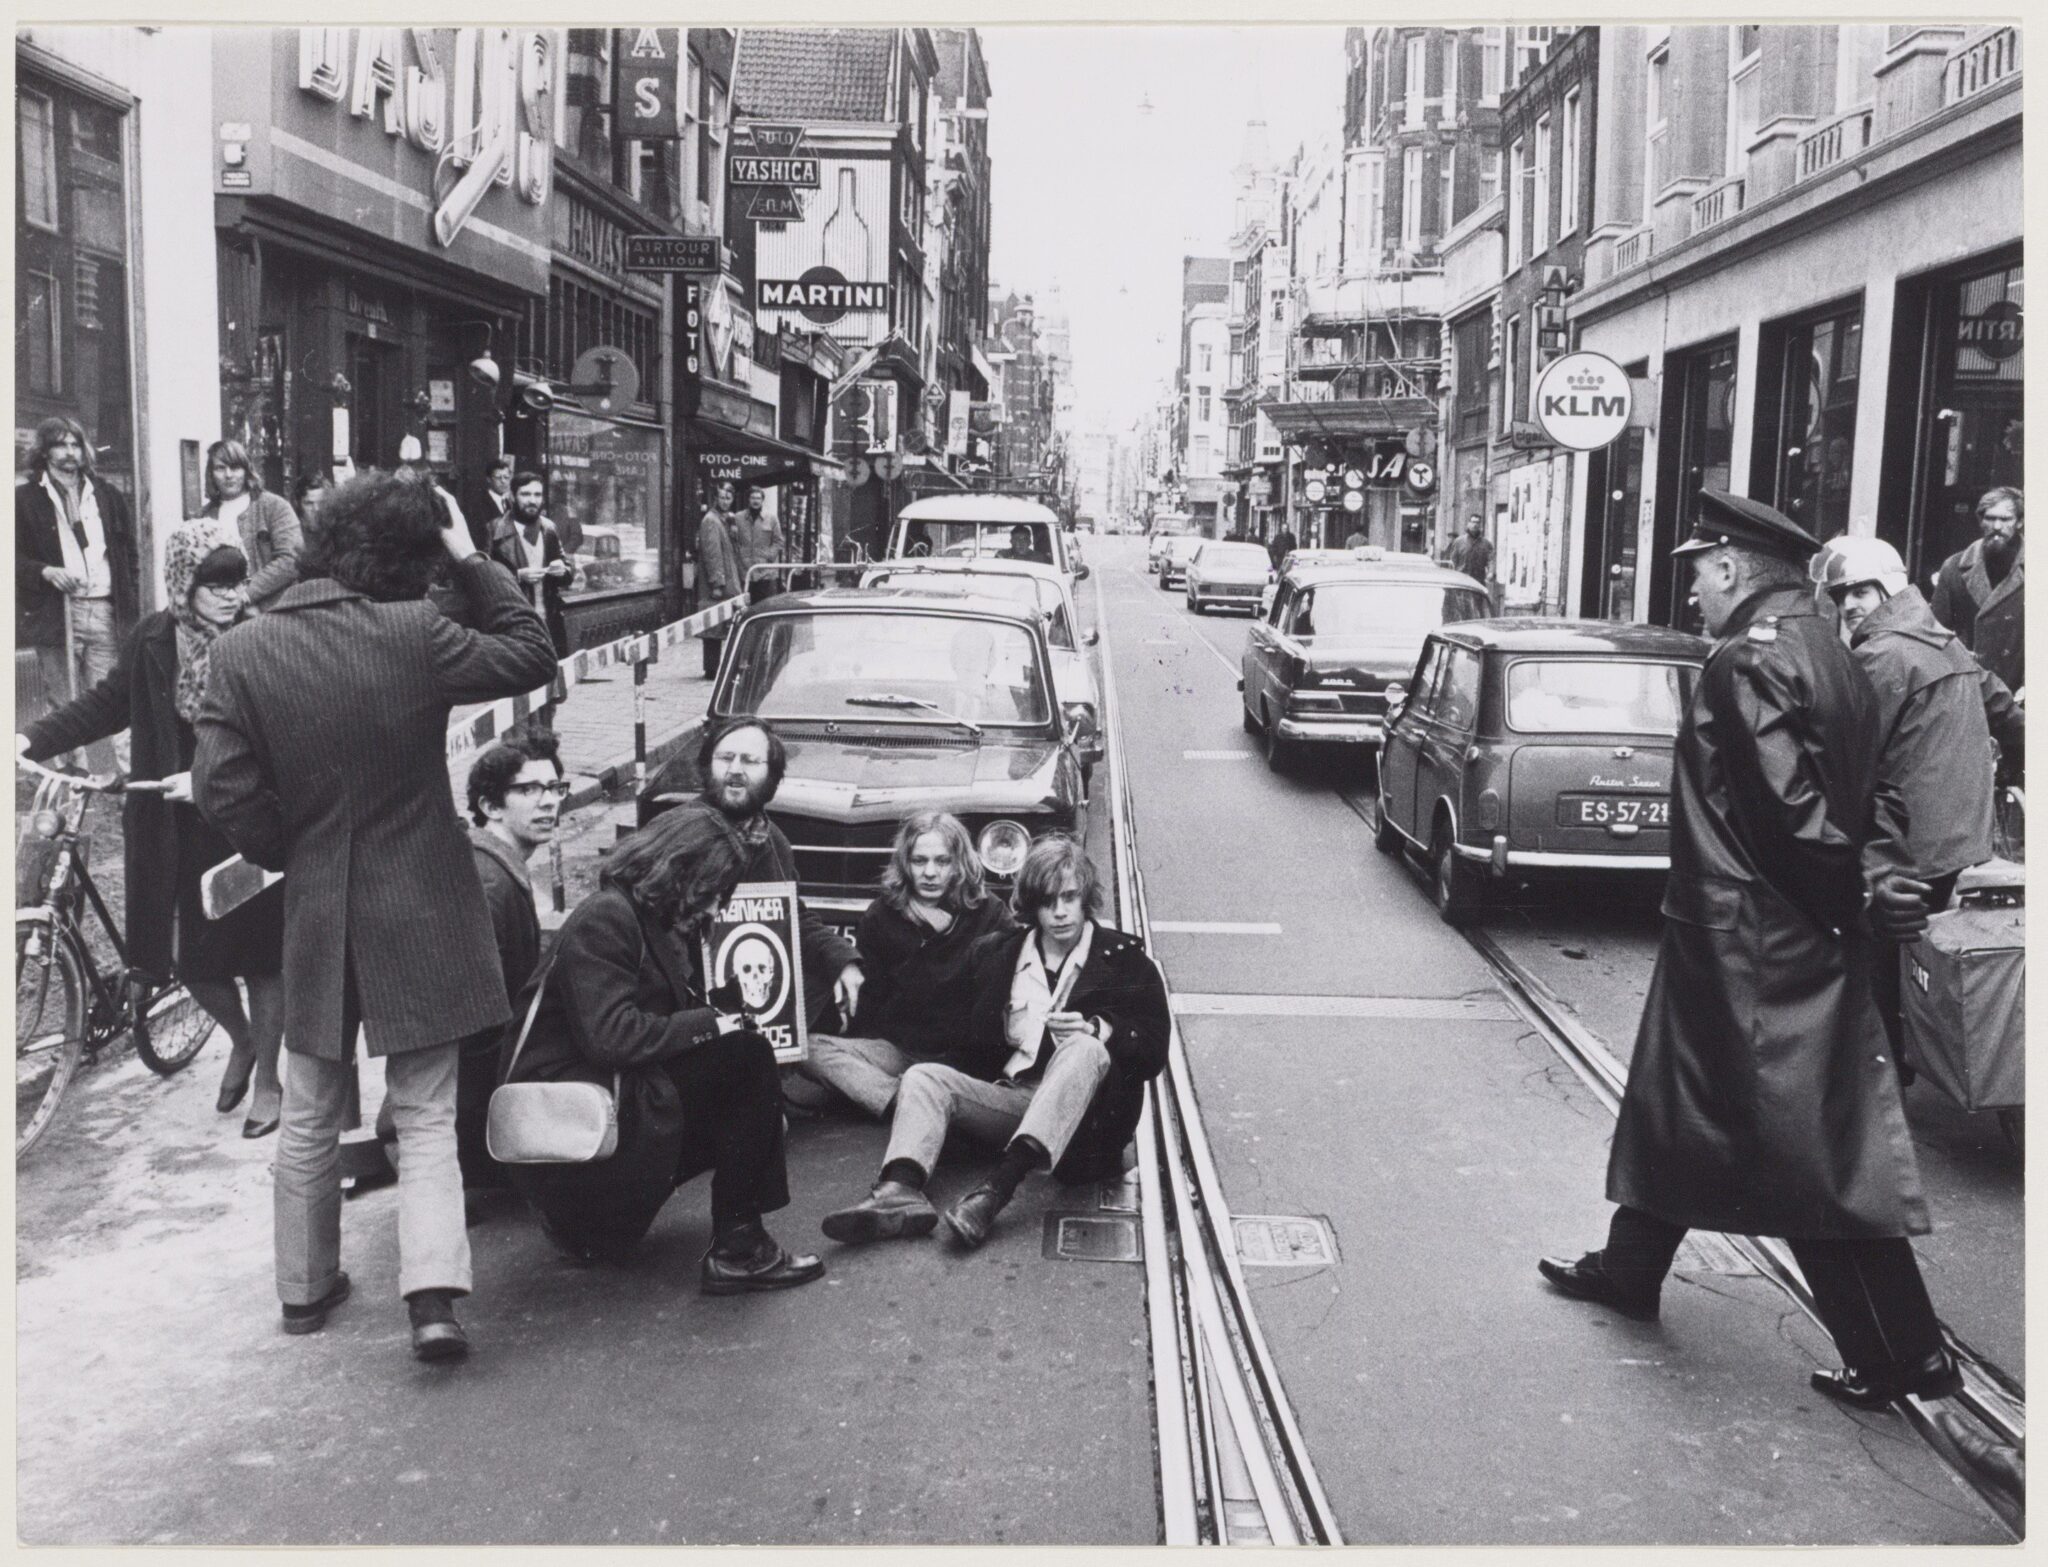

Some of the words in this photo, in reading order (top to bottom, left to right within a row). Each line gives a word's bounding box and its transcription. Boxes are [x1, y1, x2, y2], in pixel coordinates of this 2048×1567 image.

[735, 160, 815, 181] YASHICA
[634, 242, 710, 254] AIRTOUR
[639, 257, 705, 267] RAILTOUR
[762, 283, 884, 307] MARTINI
[687, 286, 699, 374] FOTO
[1545, 396, 1625, 417] KLM
